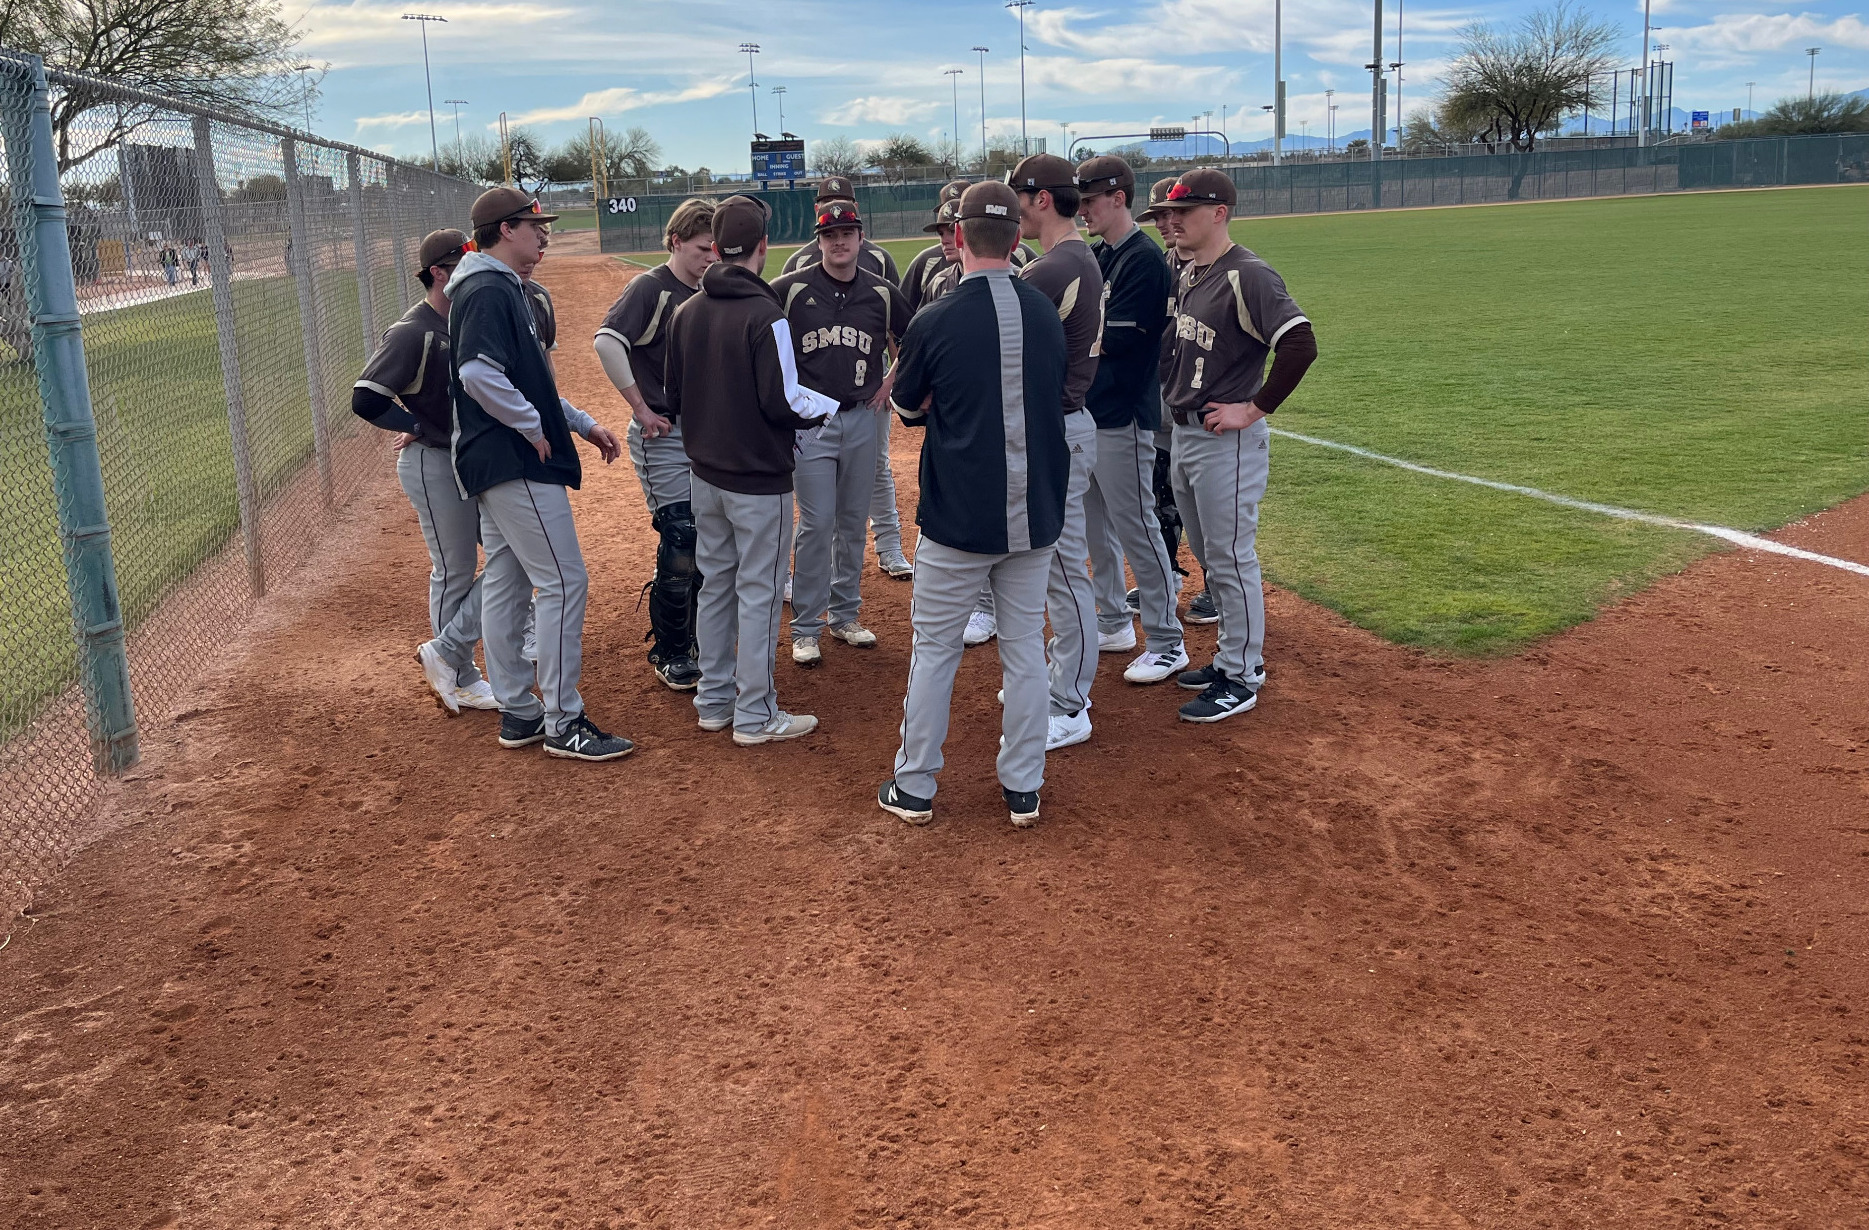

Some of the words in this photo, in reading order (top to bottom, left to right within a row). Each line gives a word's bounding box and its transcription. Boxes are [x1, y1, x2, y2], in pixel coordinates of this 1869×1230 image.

[609, 197, 637, 214] 340
[802, 325, 873, 355] SMSU
[1177, 314, 1216, 351] SU
[854, 359, 867, 387] 8
[1190, 357, 1205, 389] 1
